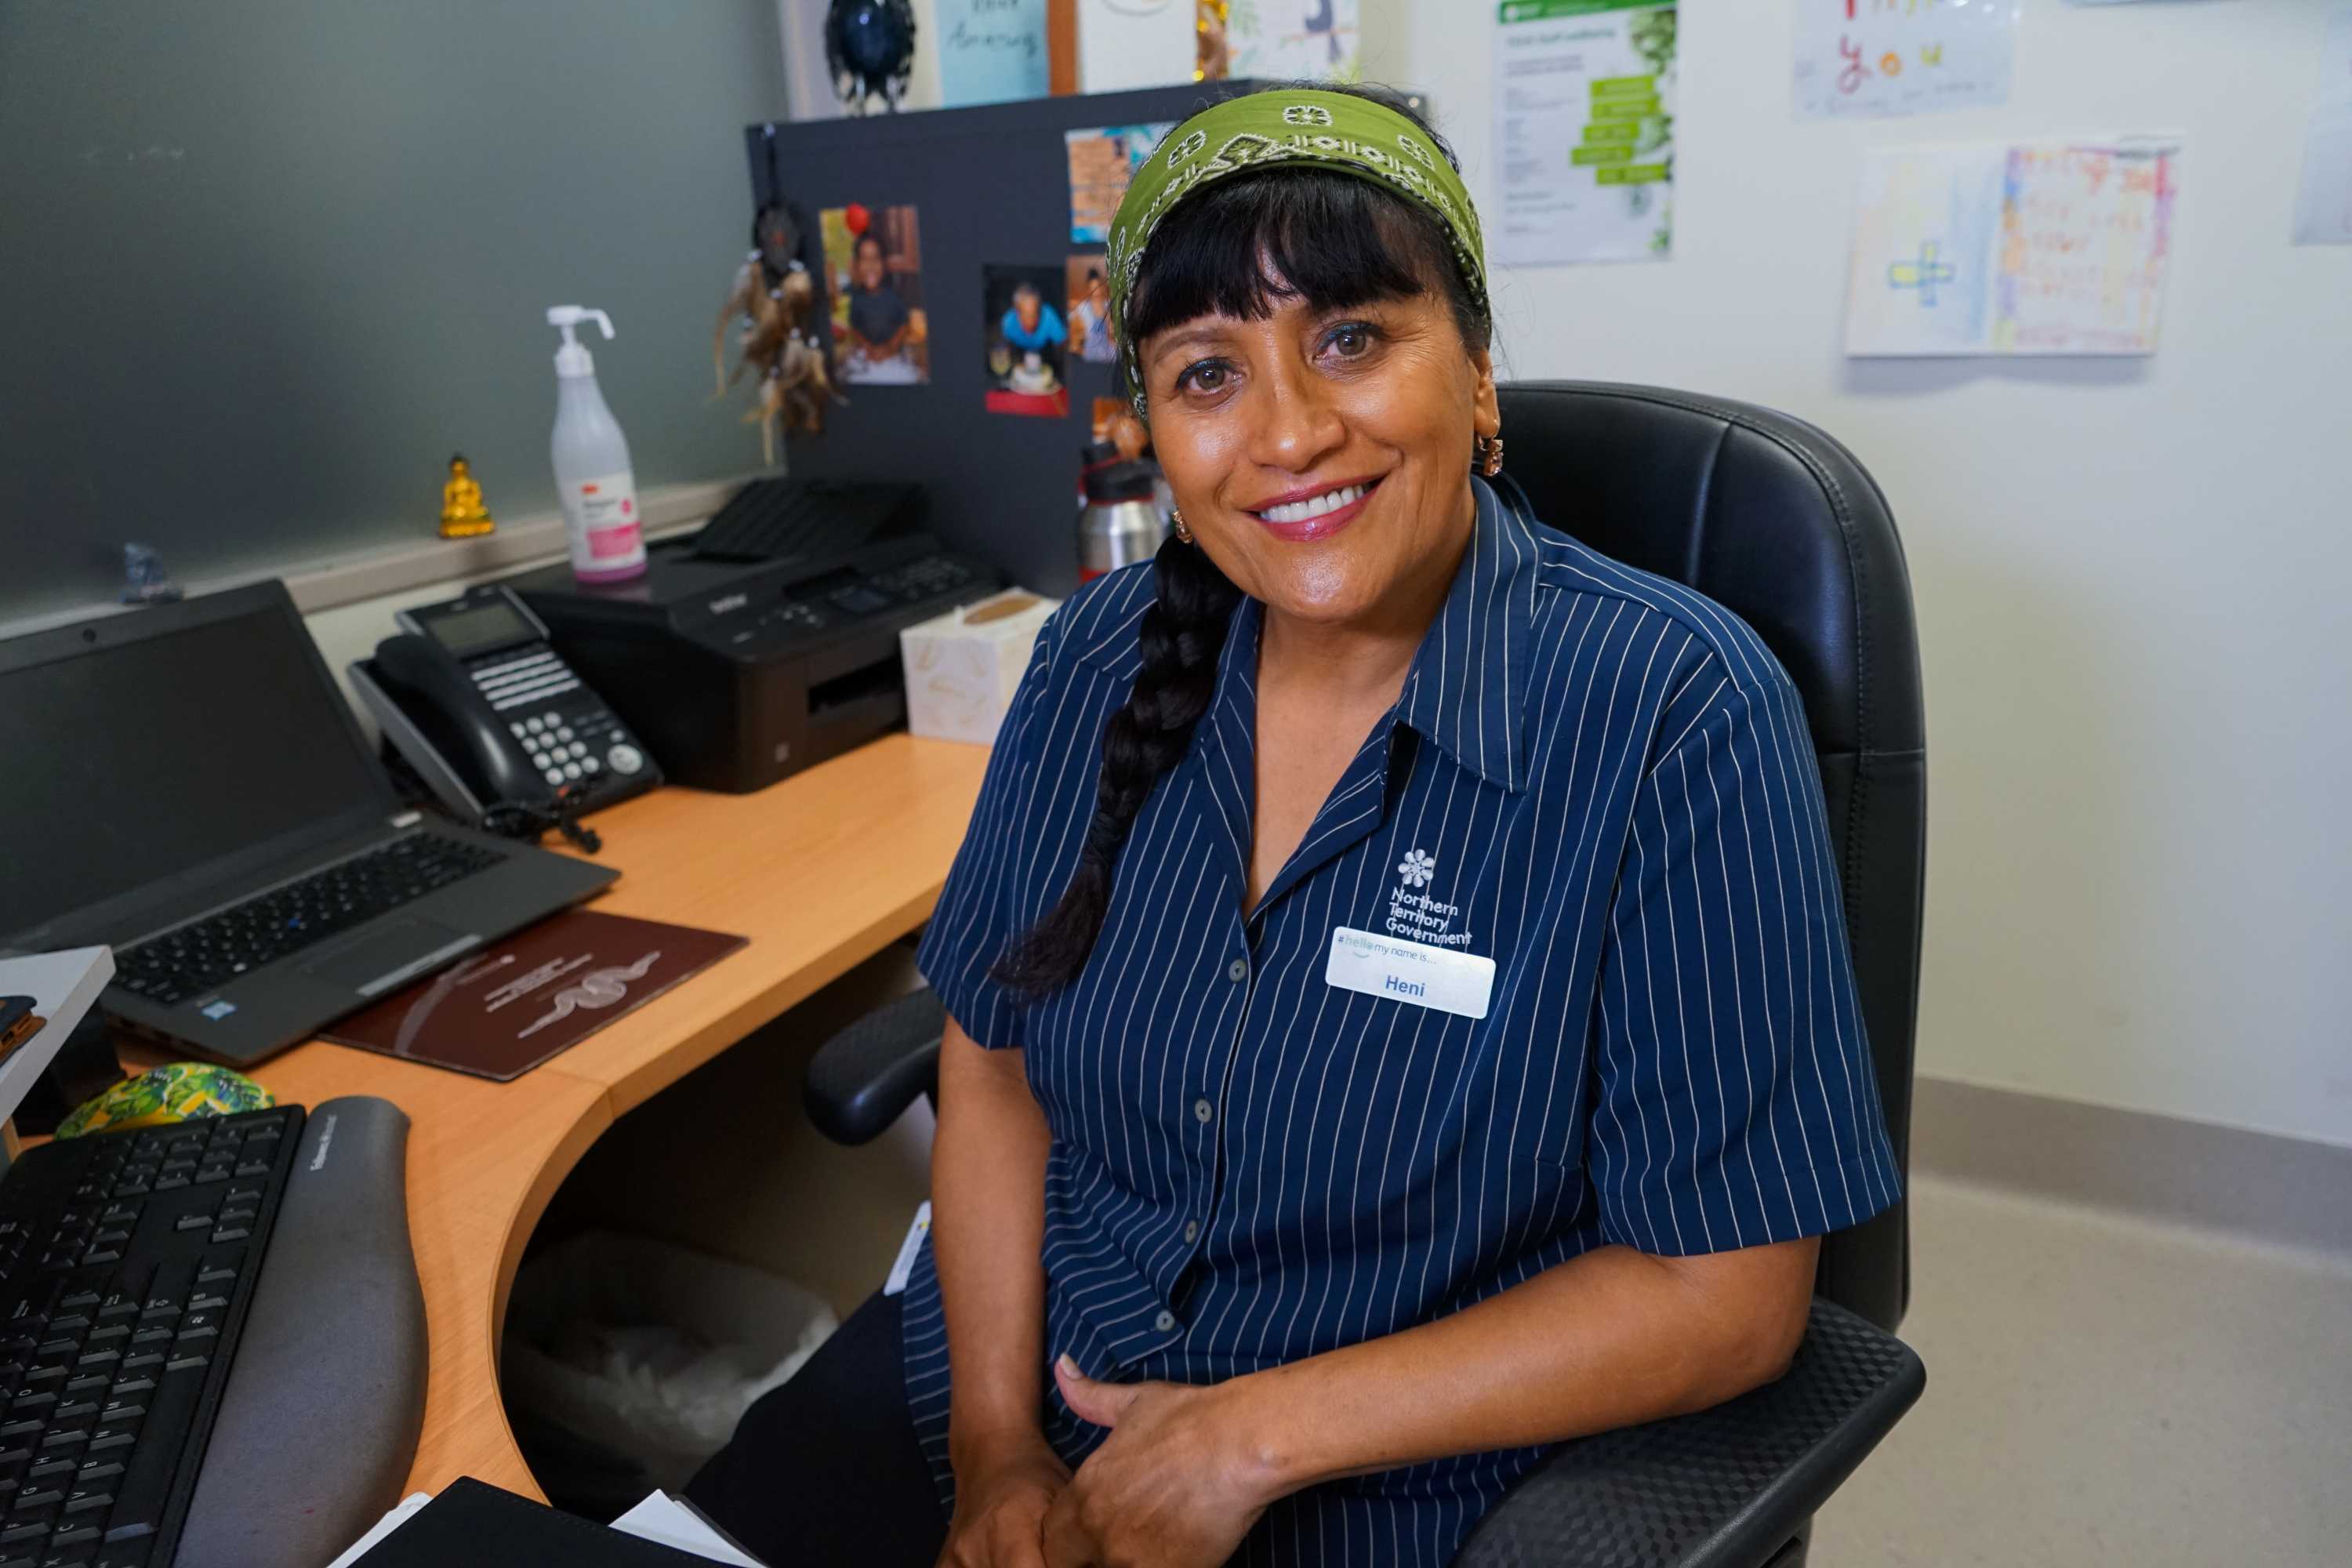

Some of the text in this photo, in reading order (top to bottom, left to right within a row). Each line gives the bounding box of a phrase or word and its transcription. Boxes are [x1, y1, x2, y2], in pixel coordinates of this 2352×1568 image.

[1836, 34, 1943, 94] you
[1391, 887, 1459, 916] Northern
[1385, 917, 1473, 946] Government
[1388, 902, 1450, 933] Territory
[1374, 943, 1390, 956] my
[1391, 947, 1418, 960] name
[1385, 975, 1426, 997] Heni
[22, 1486, 38, 1495] G
[35, 1456, 50, 1465] H
[43, 1557, 62, 1567] X
[58, 1523, 74, 1532] C
